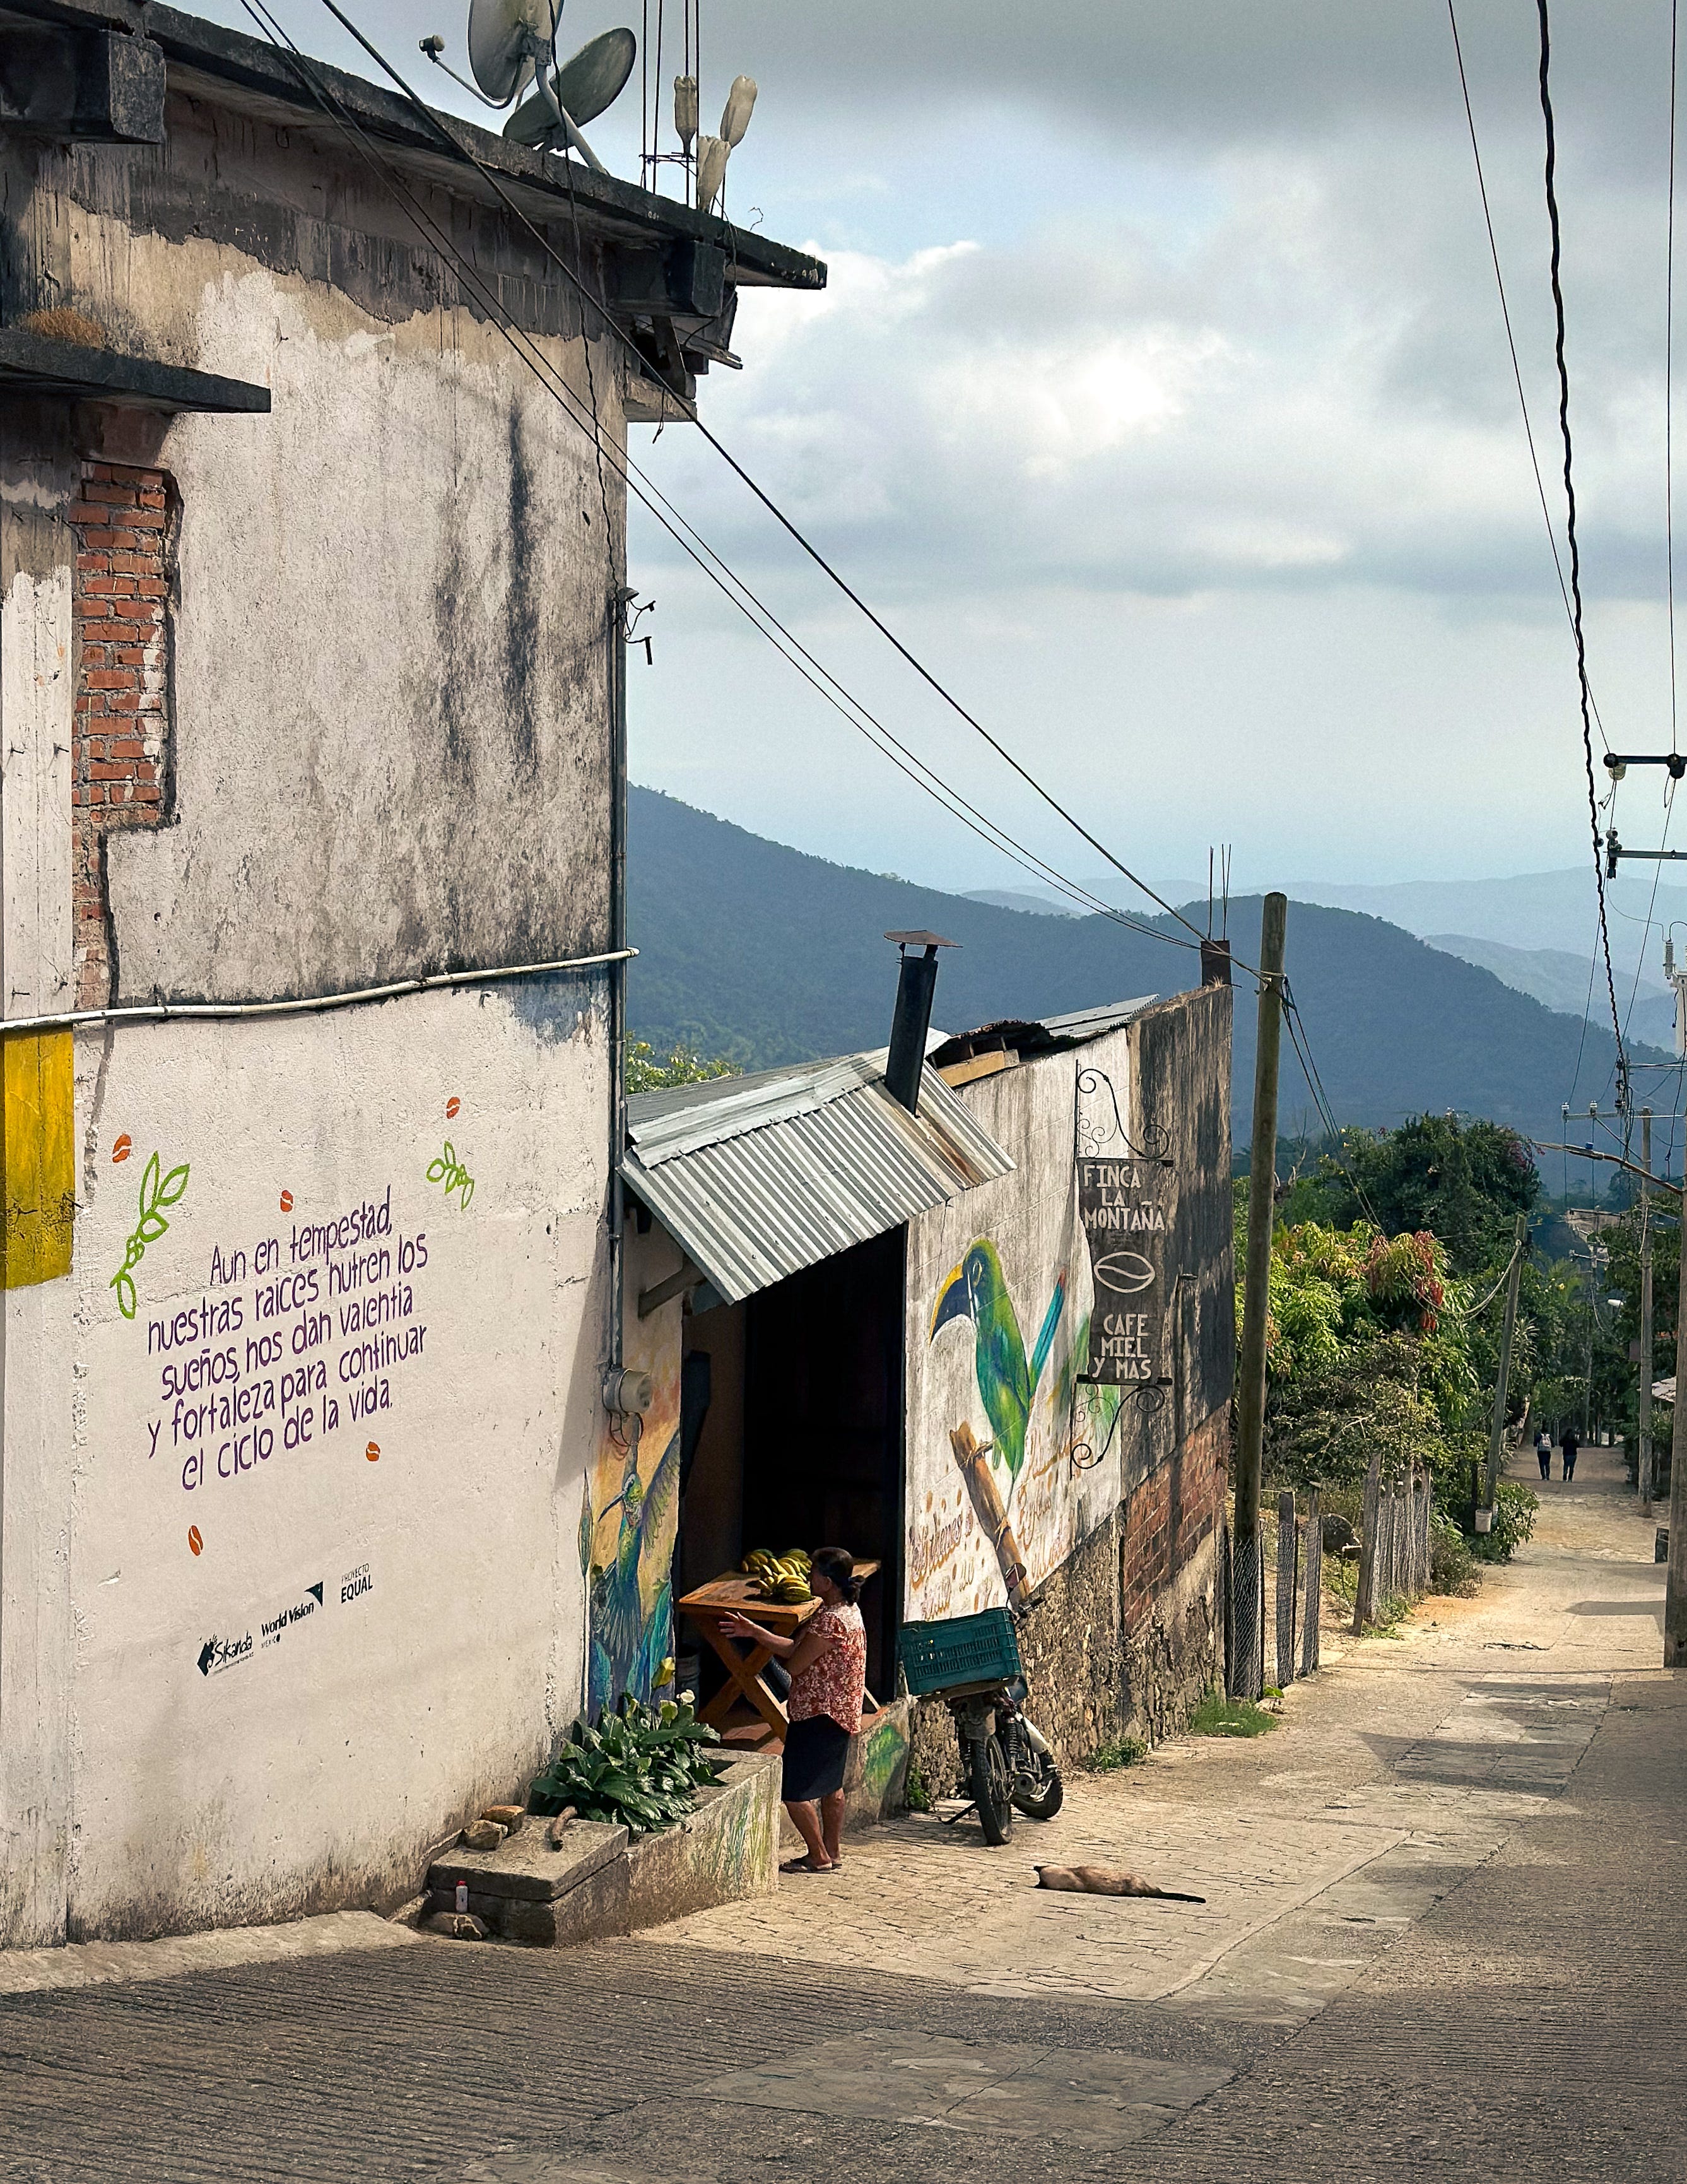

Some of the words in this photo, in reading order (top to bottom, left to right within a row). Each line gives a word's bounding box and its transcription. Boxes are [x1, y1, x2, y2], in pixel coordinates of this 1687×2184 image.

[1084, 1165, 1141, 1188] FINCA
[1102, 1188, 1125, 1207] LA
[1084, 1200, 1165, 1231] MONTAÑA
[210, 1244, 246, 1286] Aun
[255, 1238, 279, 1275] en
[290, 1184, 392, 1263] tempestad,
[148, 1296, 244, 1355] nuestras
[255, 1268, 319, 1321] raices
[329, 1247, 389, 1297] nutren
[398, 1234, 428, 1273] los
[1103, 1314, 1148, 1337] CAFE
[162, 1346, 240, 1401] sueños,
[246, 1330, 283, 1374] nos
[292, 1311, 332, 1354] dan
[340, 1282, 413, 1337] valentia
[1102, 1337, 1148, 1357] MIEL
[1116, 1359, 1151, 1379] MAS
[148, 1419, 162, 1459] y
[172, 1377, 274, 1446] fortaleza
[281, 1357, 326, 1419] para
[339, 1325, 426, 1382] continuar
[182, 1449, 204, 1490] el
[218, 1427, 273, 1478] ciclo
[284, 1406, 314, 1451] de
[323, 1394, 339, 1434] la
[349, 1375, 392, 1423] vida.
[341, 1563, 369, 1584] PROYECTO
[341, 1574, 373, 1603] EQUAL
[261, 1610, 286, 1637] World
[289, 1602, 314, 1624] Vision
